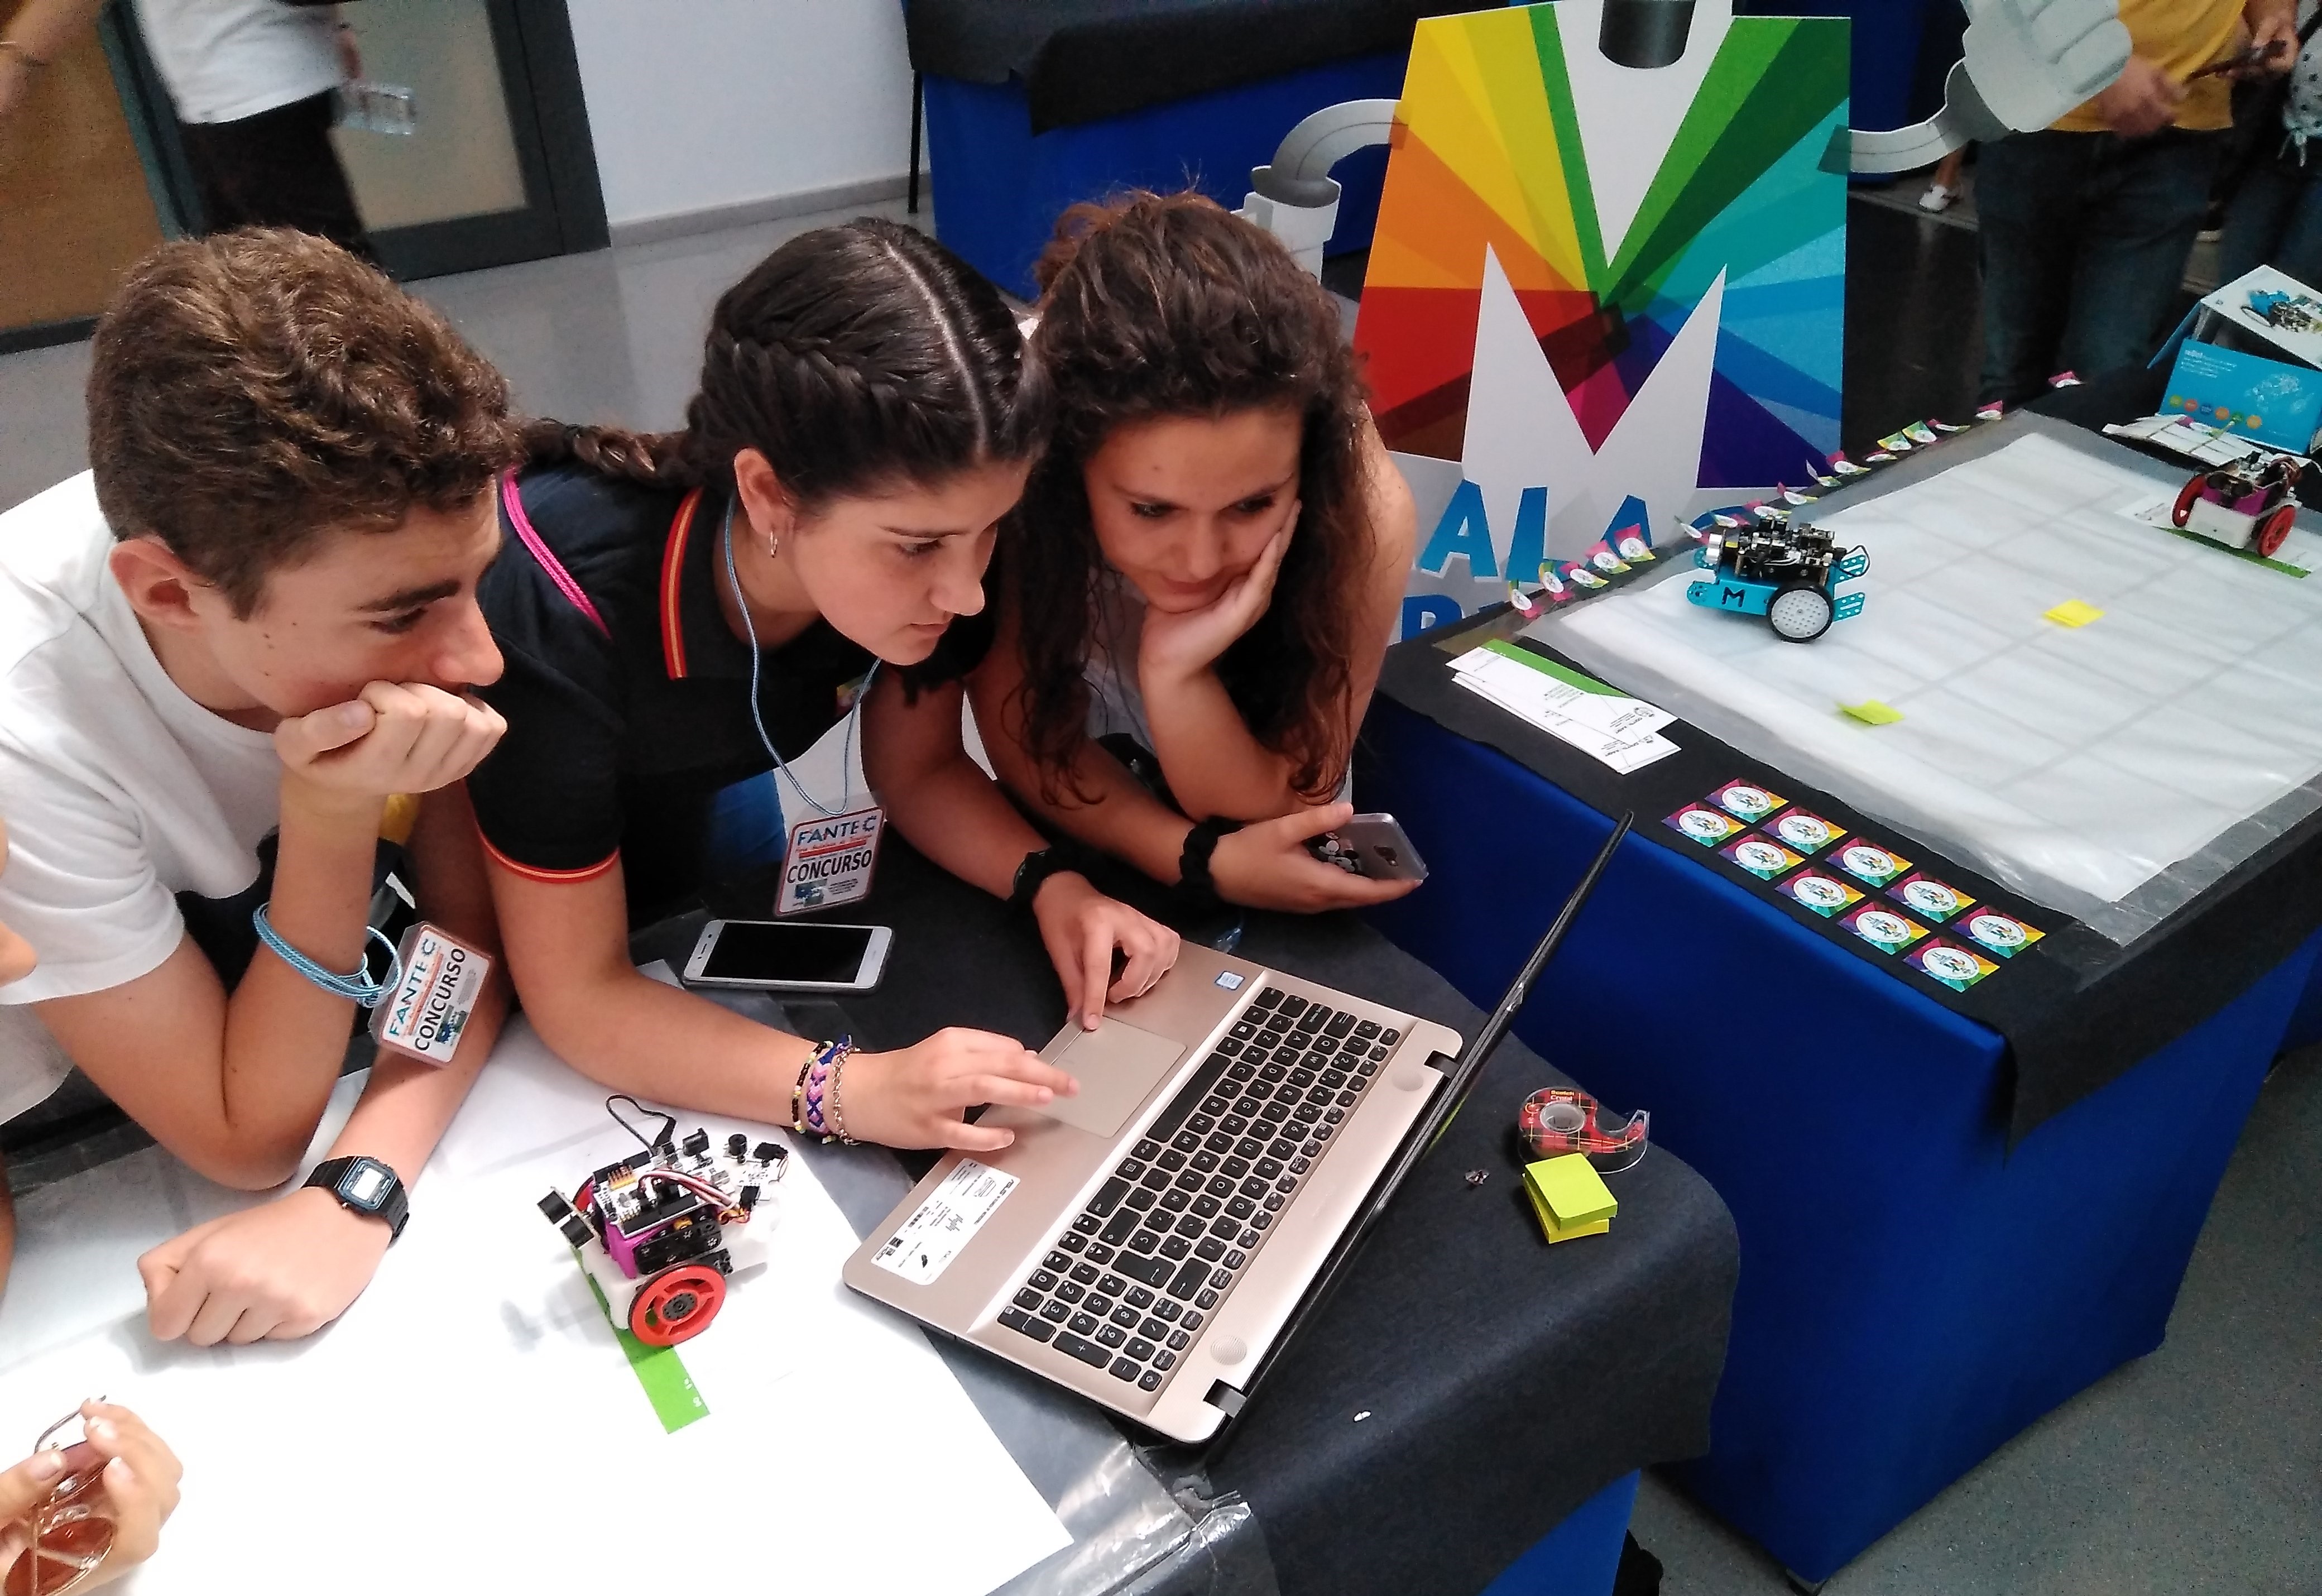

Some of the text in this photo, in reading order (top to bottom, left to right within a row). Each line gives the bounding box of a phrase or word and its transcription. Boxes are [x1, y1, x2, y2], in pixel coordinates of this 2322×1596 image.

[1416, 478, 1753, 583] ALA
[1721, 586, 1745, 608] M
[786, 849, 873, 884] CONCURSO
[415, 947, 466, 1051] CONCURSO
[1249, 1050, 1260, 1058] X
[1309, 1055, 1320, 1065] W
[1256, 1084, 1265, 1092] F
[1283, 1089, 1294, 1097] R
[1210, 1100, 1220, 1109] B
[1241, 1101, 1252, 1110] G
[1303, 1107, 1313, 1115] 5
[1195, 1118, 1206, 1127] N
[1227, 1118, 1239, 1128] H
[1290, 1125, 1299, 1133] 6
[1180, 1135, 1192, 1145] M
[1244, 1142, 1254, 1152] U
[1278, 1143, 1288, 1152] 7
[1200, 1155, 1211, 1164] K
[1263, 1162, 1274, 1171] 8
[999, 1178, 1014, 1196] ASUS
[1215, 1180, 1226, 1190] O
[1250, 1182, 1260, 1190] 9
[1202, 1200, 1211, 1209] P
[1080, 1268, 1090, 1276] 1
[1106, 1279, 1116, 1288] 4
[1064, 1286, 1075, 1295] 2
[1135, 1291, 1146, 1301] 7
[1092, 1298, 1102, 1308] 5
[1050, 1305, 1061, 1314] 3
[1119, 1310, 1130, 1320] 8
[1077, 1317, 1087, 1326] 6
[1106, 1330, 1117, 1339] 9
